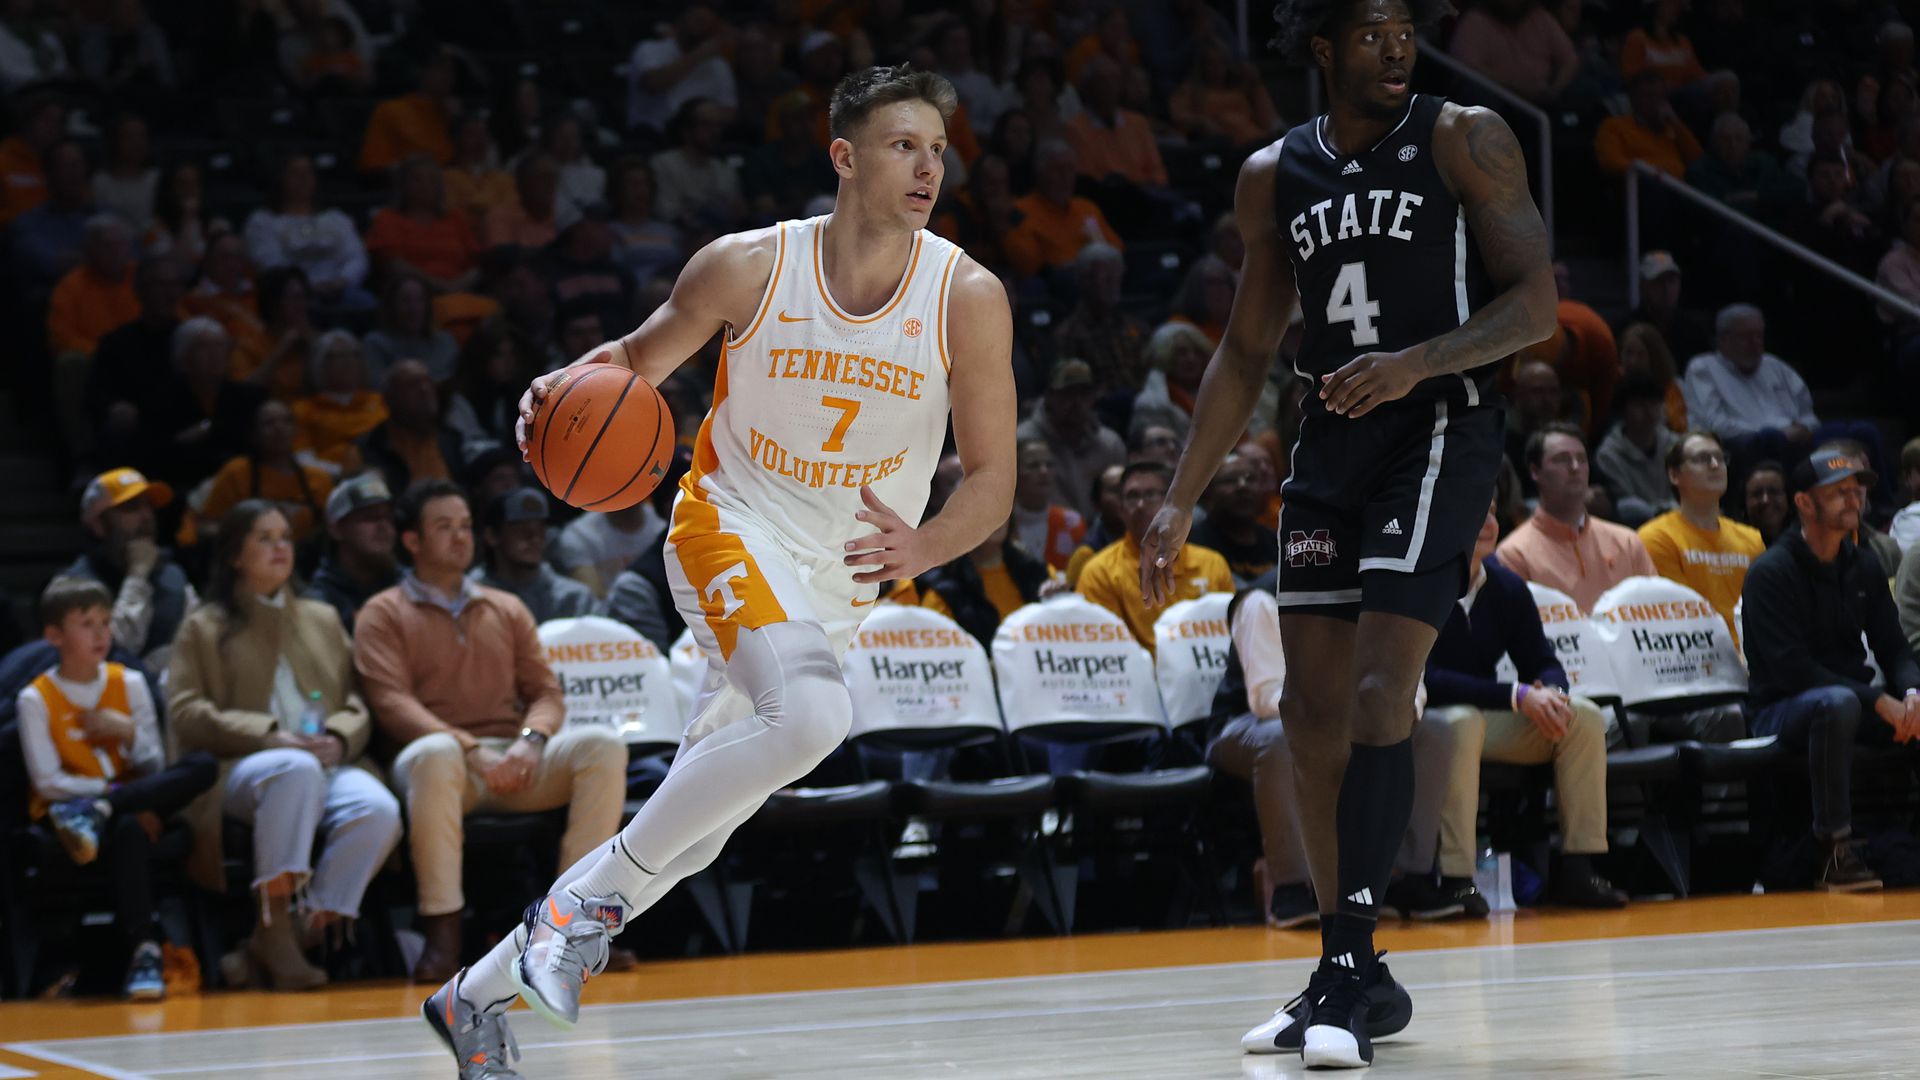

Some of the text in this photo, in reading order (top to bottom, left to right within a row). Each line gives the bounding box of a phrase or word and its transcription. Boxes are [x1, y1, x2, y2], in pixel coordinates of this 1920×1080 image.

[1399, 145, 1416, 161] SEC
[1341, 166, 1363, 175] adidas
[1290, 189, 1424, 262] STATE
[1325, 260, 1381, 348] 4
[904, 320, 921, 336] SEC
[768, 348, 925, 400] TENNESSEE
[821, 395, 861, 452] 7
[750, 427, 910, 488] VOLUNTEERS
[1293, 541, 1327, 554] STATE
[705, 561, 748, 620] T
[1604, 602, 1713, 624] TENNESSE
[1632, 627, 1714, 654] Harper
[871, 655, 965, 684] Harper
[1035, 649, 1128, 678] Harper
